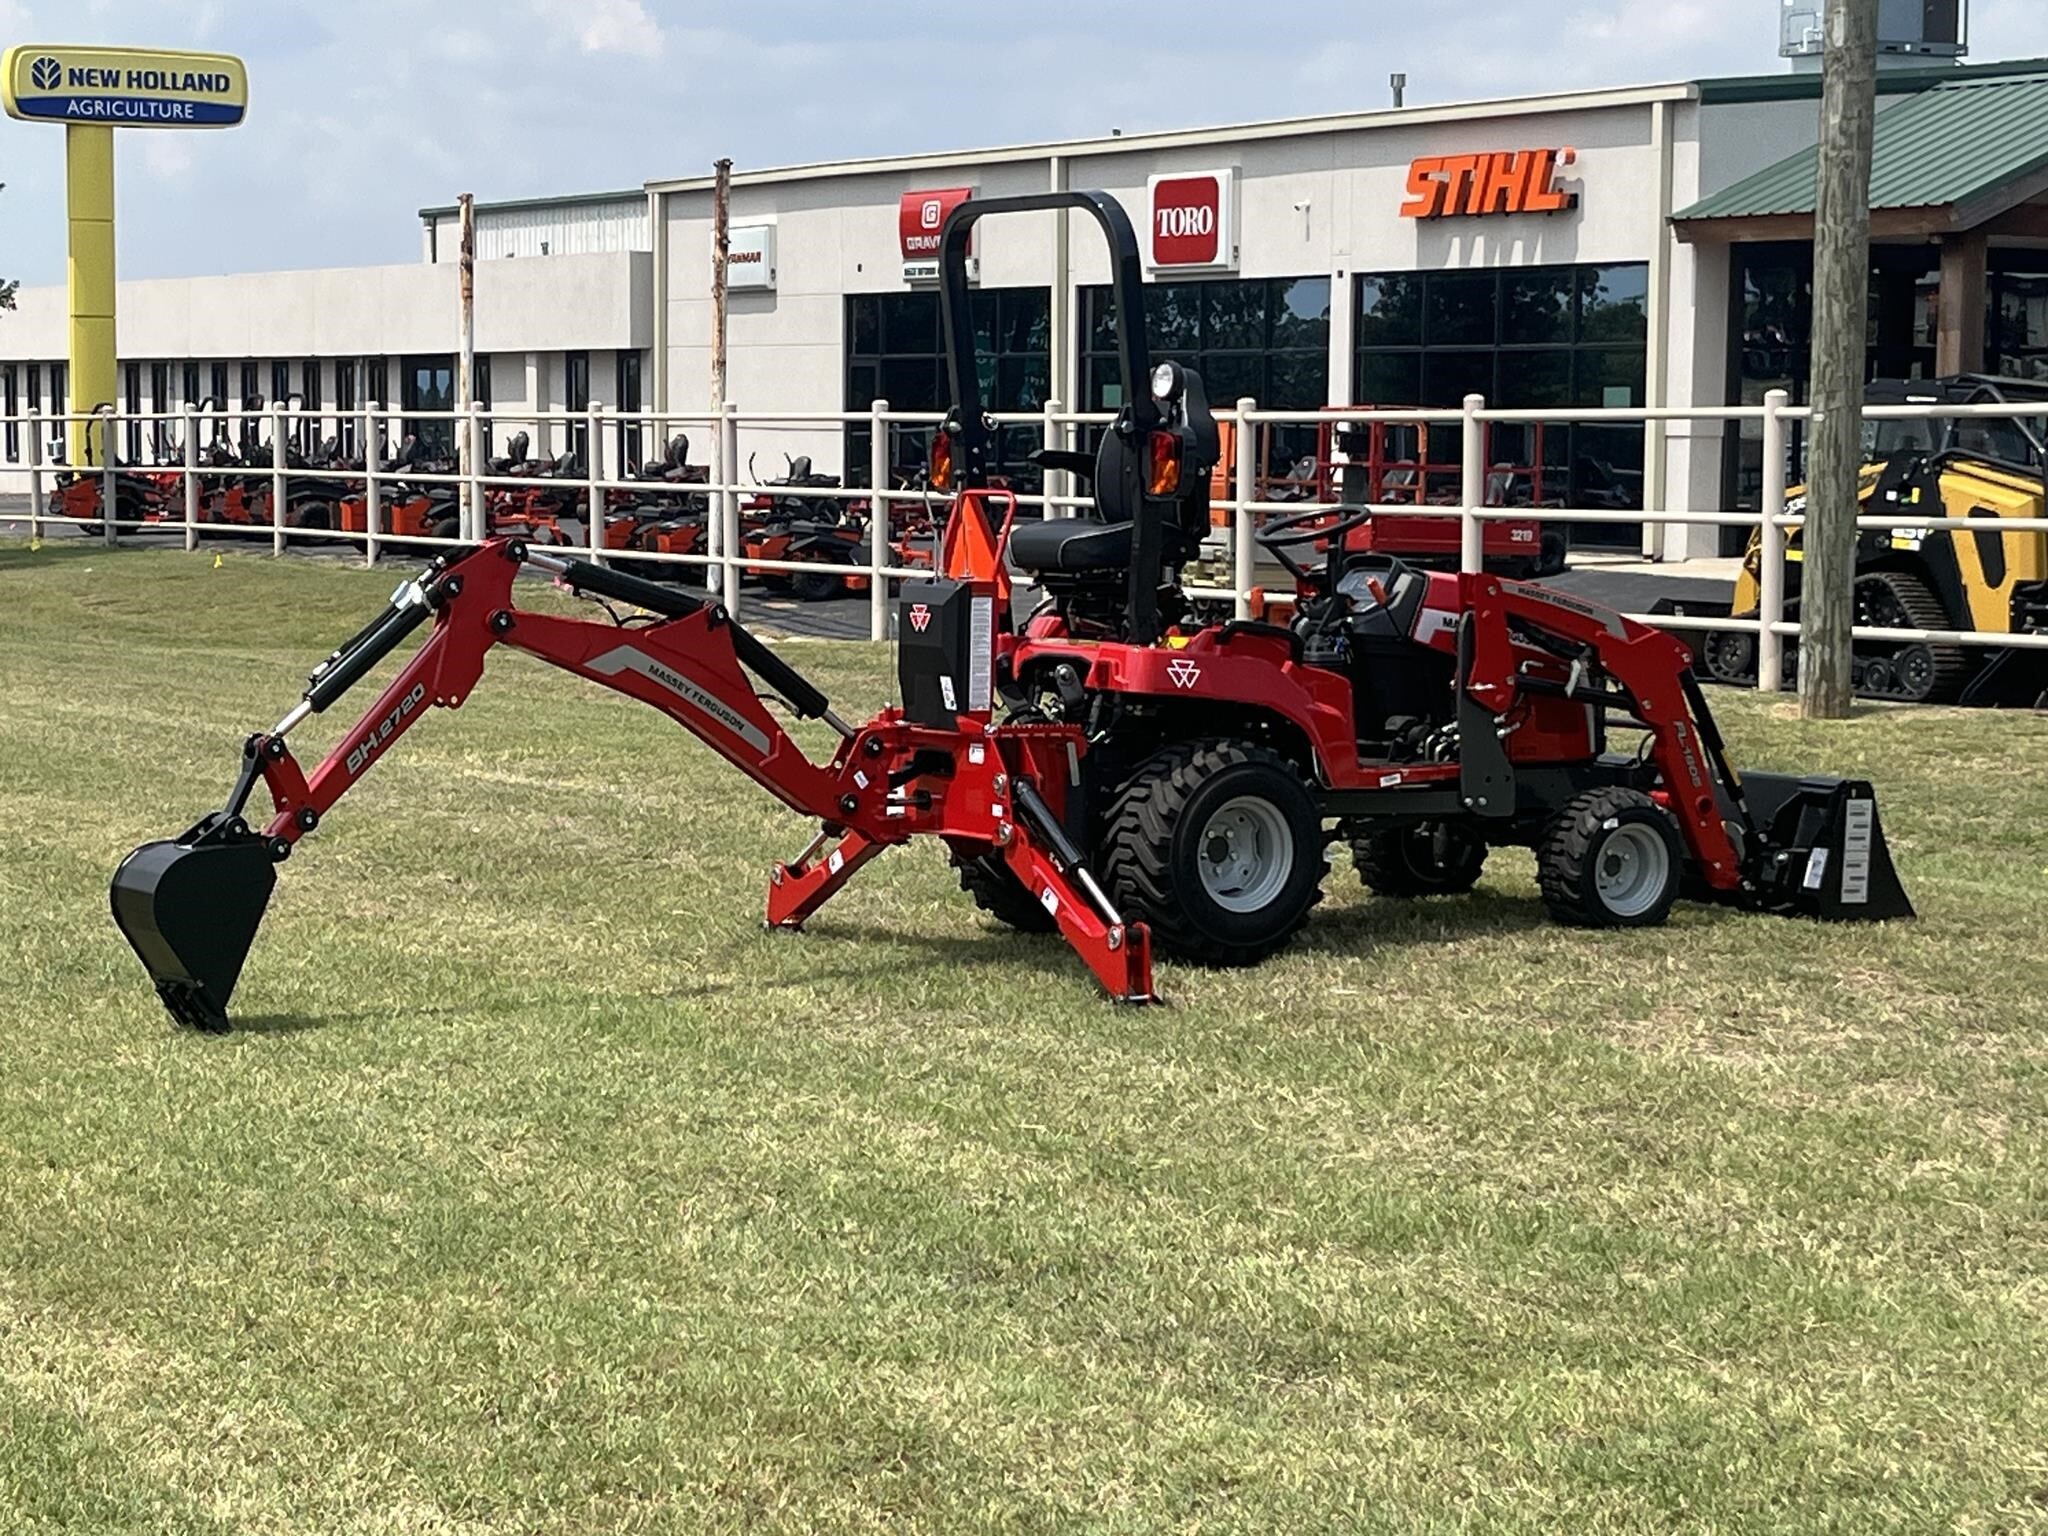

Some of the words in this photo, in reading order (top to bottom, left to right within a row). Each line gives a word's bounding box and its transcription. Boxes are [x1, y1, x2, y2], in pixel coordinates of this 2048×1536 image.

[68, 68, 121, 88] NEW
[127, 70, 231, 93] HOLLAND
[66, 99, 195, 119] AGRICULTURE
[1400, 149, 1563, 217] STIHL
[1157, 205, 1214, 237] TORO
[648, 664, 692, 695] MASSEY
[692, 691, 745, 731] FERGUSON
